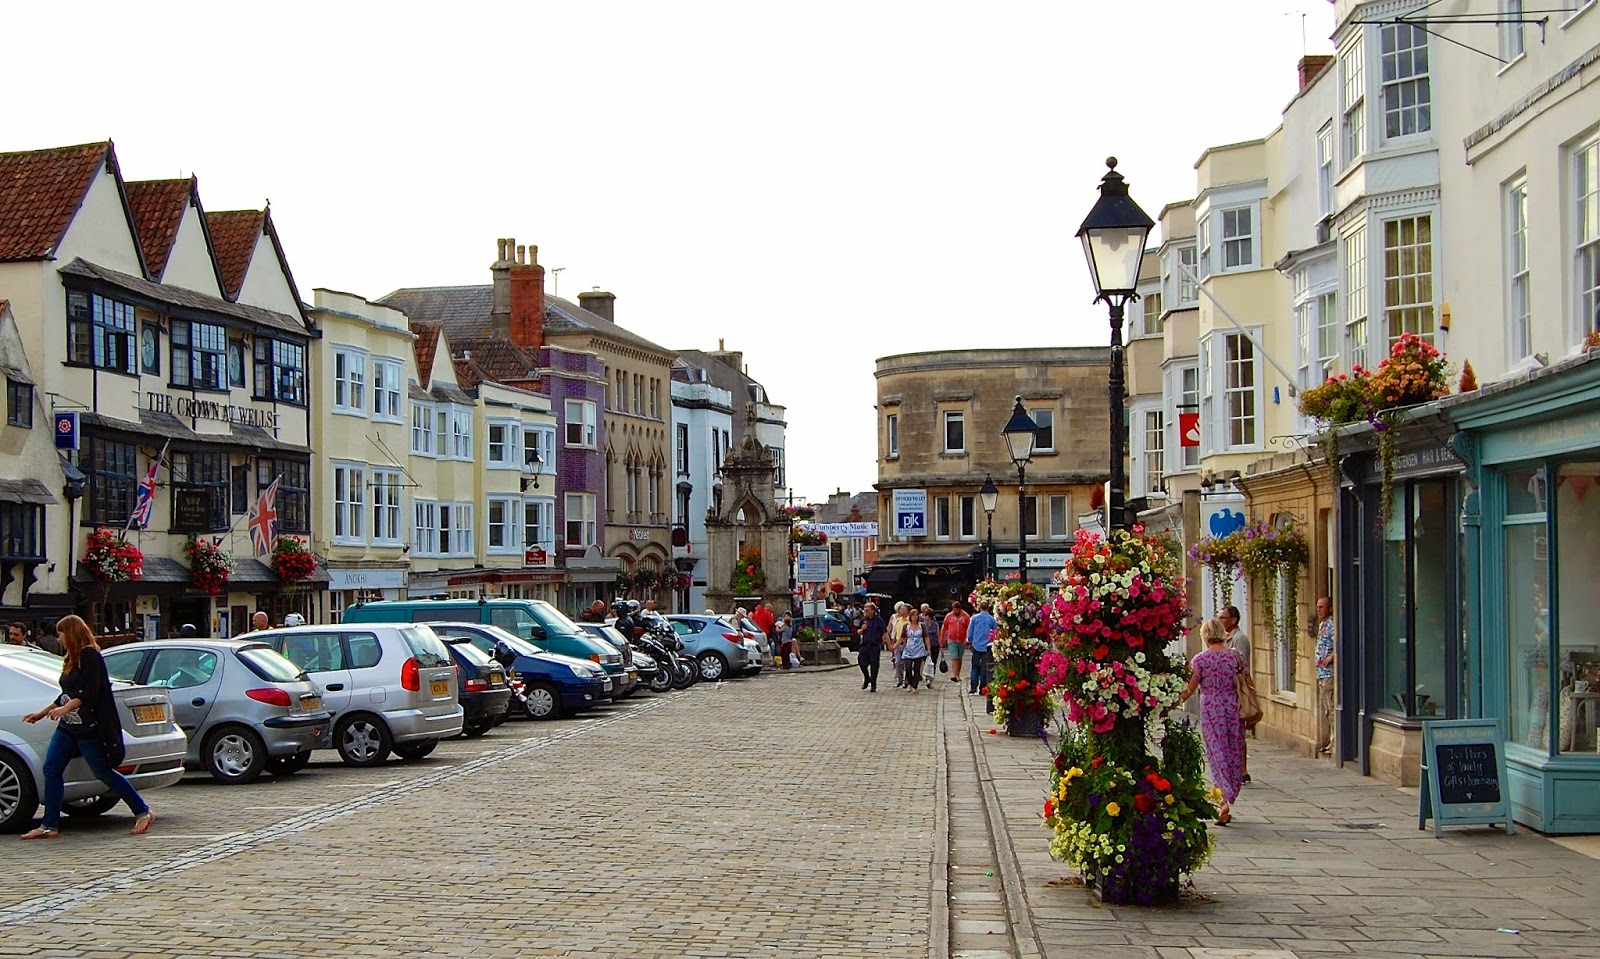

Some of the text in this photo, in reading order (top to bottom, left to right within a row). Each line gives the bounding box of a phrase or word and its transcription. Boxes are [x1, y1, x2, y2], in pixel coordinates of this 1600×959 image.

[147, 391, 274, 429] THE CROWN AT WELLS
[1421, 449, 1435, 465] HAIR
[849, 522, 868, 531] Music
[903, 513, 920, 528] pjk
[1466, 729, 1494, 737] Brown
[1459, 760, 1483, 776] lovely
